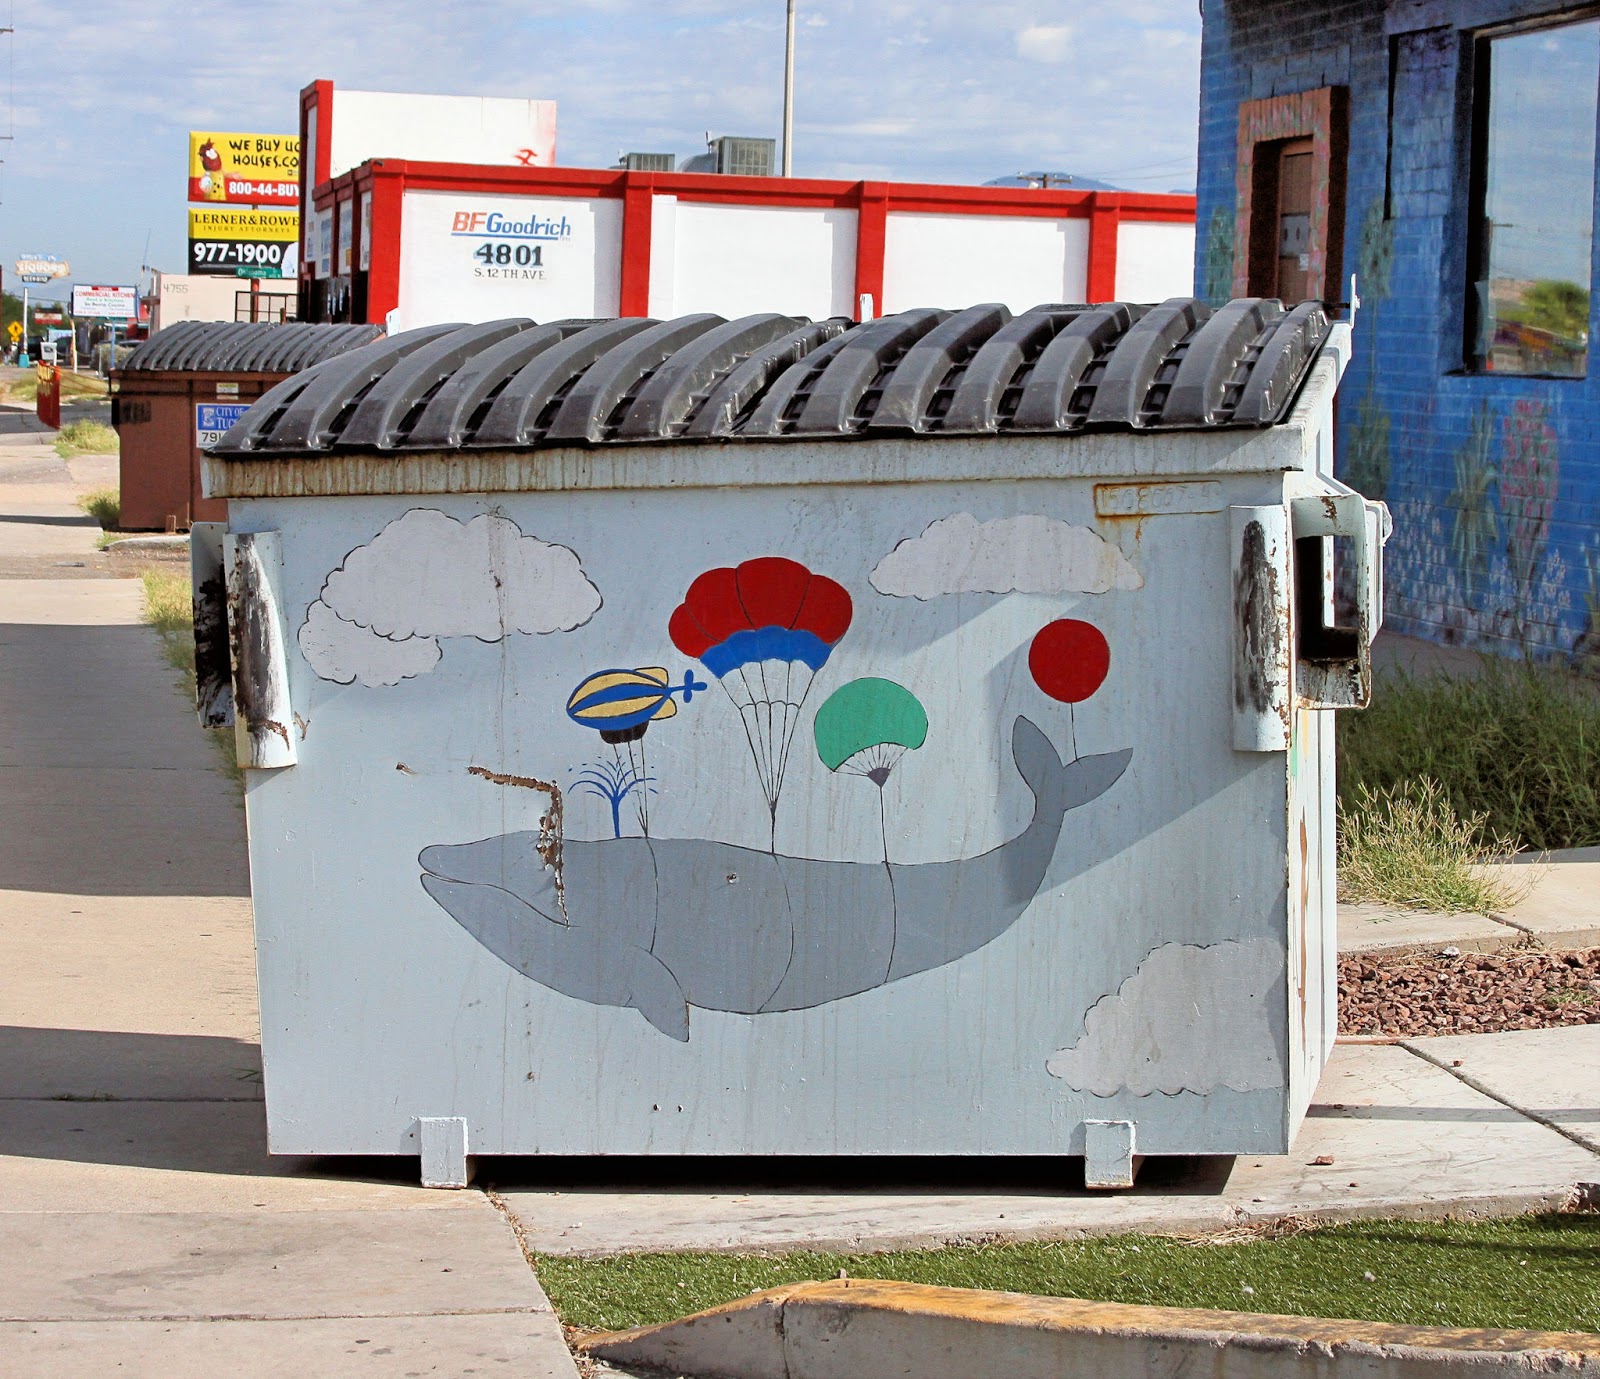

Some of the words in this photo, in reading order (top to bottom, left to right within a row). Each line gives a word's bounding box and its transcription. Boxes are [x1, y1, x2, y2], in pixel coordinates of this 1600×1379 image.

[229, 139, 250, 150] WE
[256, 138, 280, 152] BUY
[228, 181, 299, 197] 800-44-BUY
[452, 210, 571, 236] BFGoodrich
[193, 242, 281, 264] 977-1900
[474, 243, 544, 267] 4801
[474, 267, 485, 277] S.
[163, 283, 189, 294] 4755
[216, 407, 233, 417] CITY
[216, 417, 237, 429] TUC
